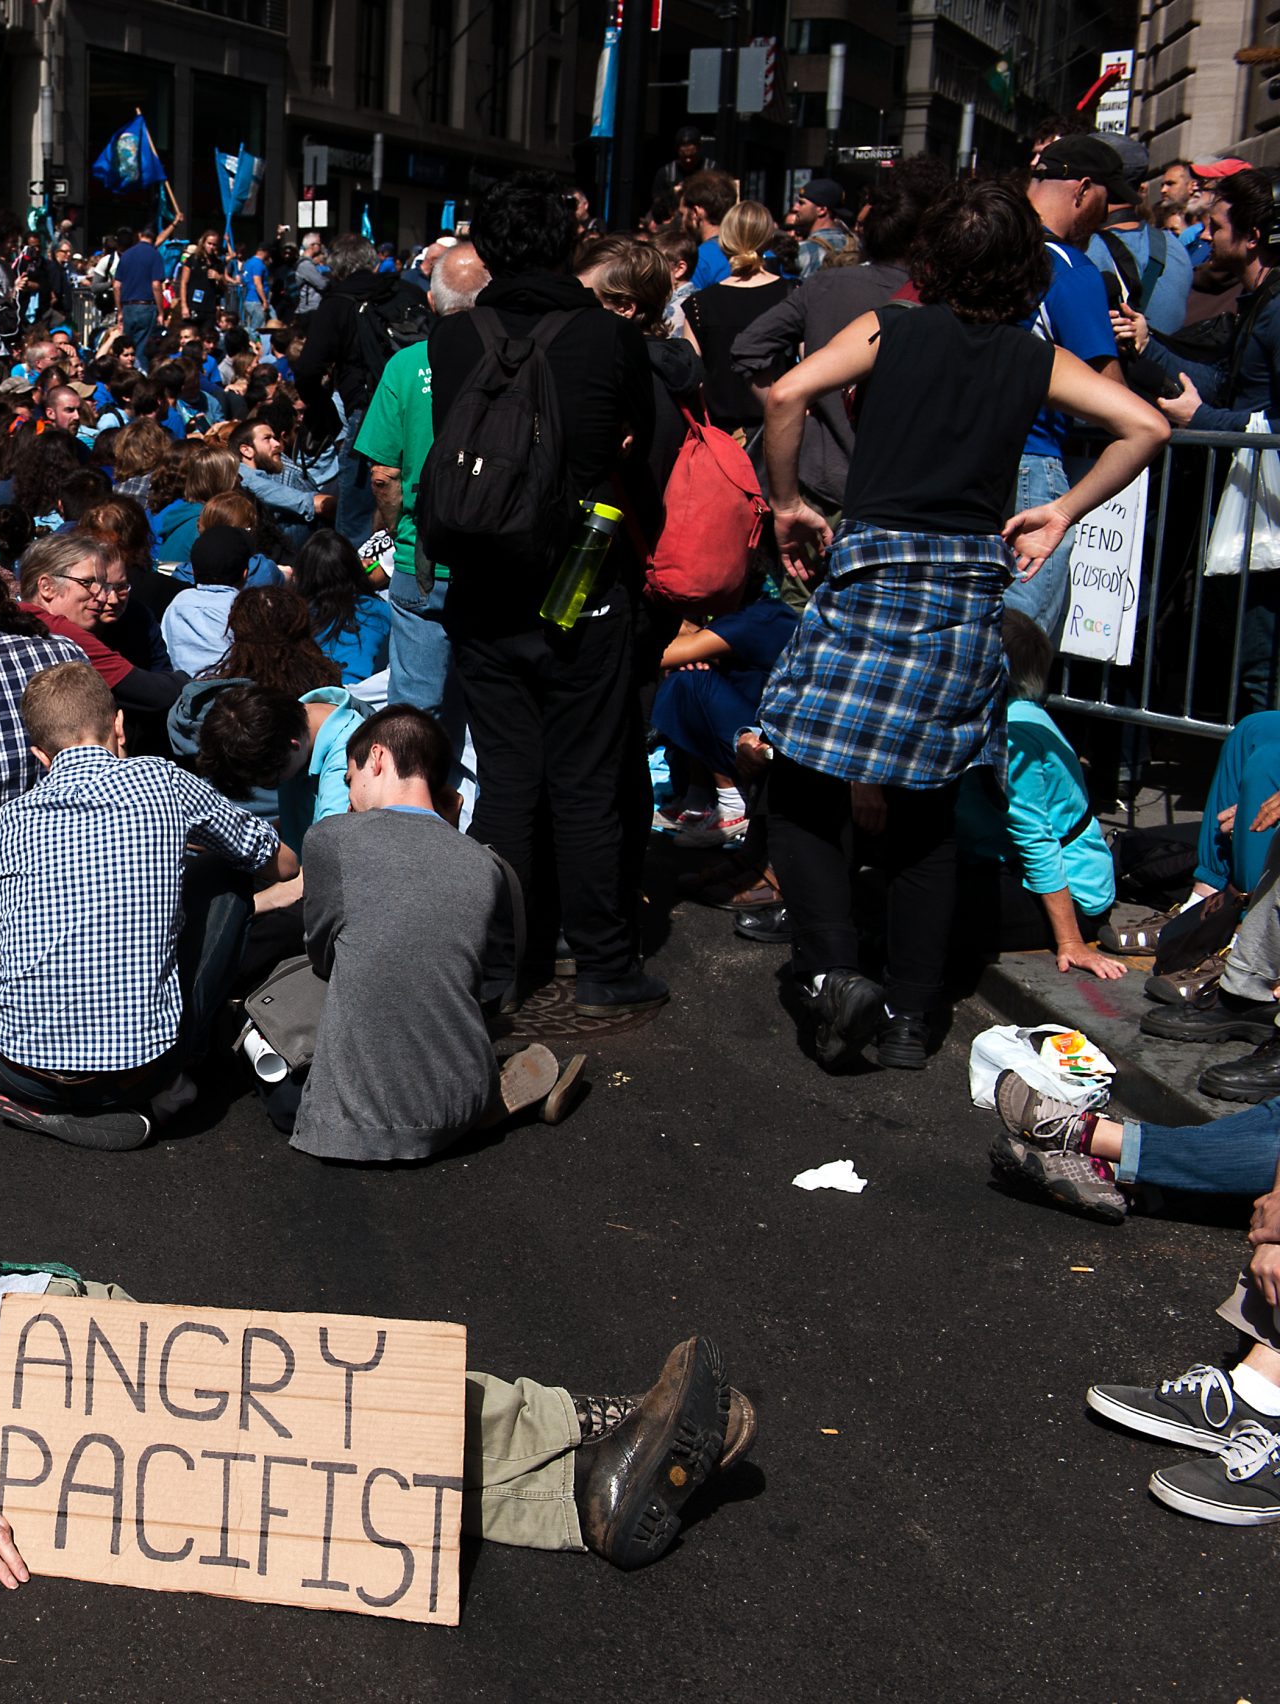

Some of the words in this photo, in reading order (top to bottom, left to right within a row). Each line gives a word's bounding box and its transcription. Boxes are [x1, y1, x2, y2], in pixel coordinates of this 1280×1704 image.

[1098, 121, 1125, 132] LUNCH
[855, 149, 893, 159] MORRIS
[1072, 562, 1127, 597] CUSTODY
[1070, 604, 1111, 638] Race
[12, 1313, 387, 1449] ANGRY
